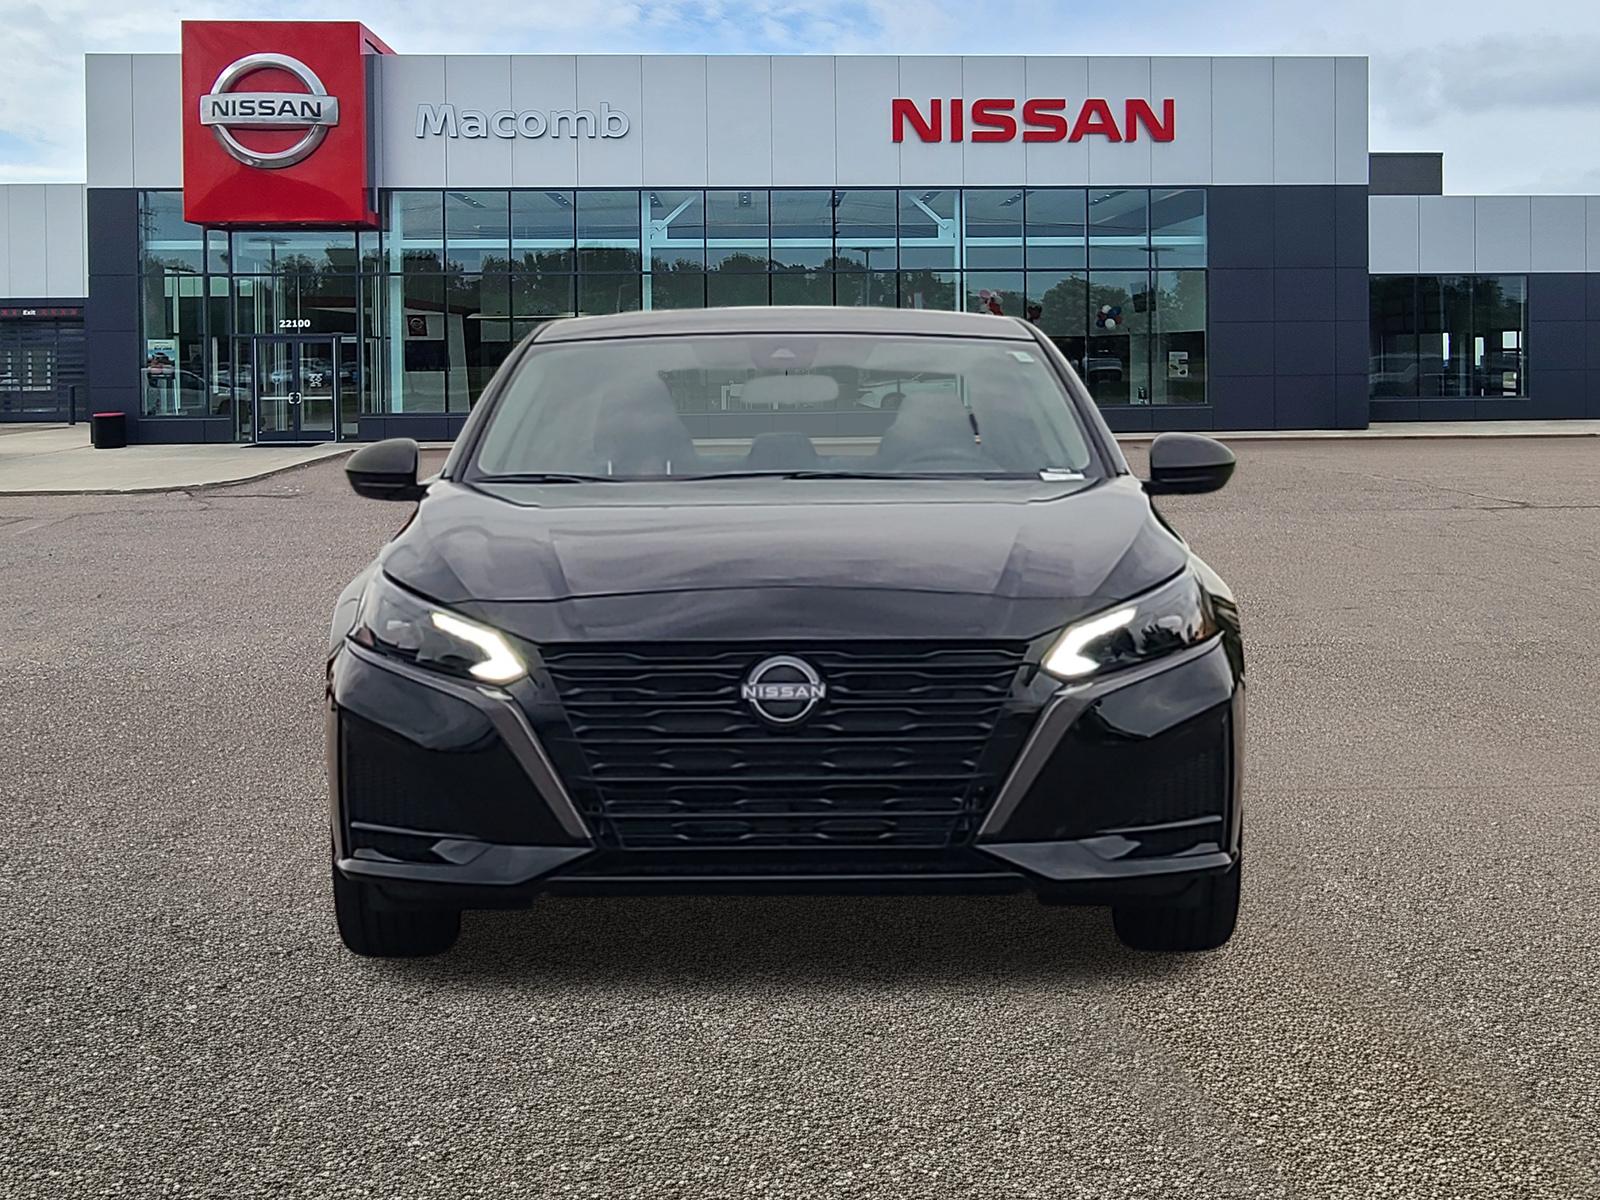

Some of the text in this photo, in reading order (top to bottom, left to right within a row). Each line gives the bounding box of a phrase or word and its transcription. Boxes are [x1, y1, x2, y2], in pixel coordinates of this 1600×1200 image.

[211, 100, 322, 118] NISSAN
[415, 101, 631, 139] Macomb
[891, 98, 1176, 143] NISSAN
[279, 319, 311, 328] 22100
[741, 683, 827, 699] NISSAN
